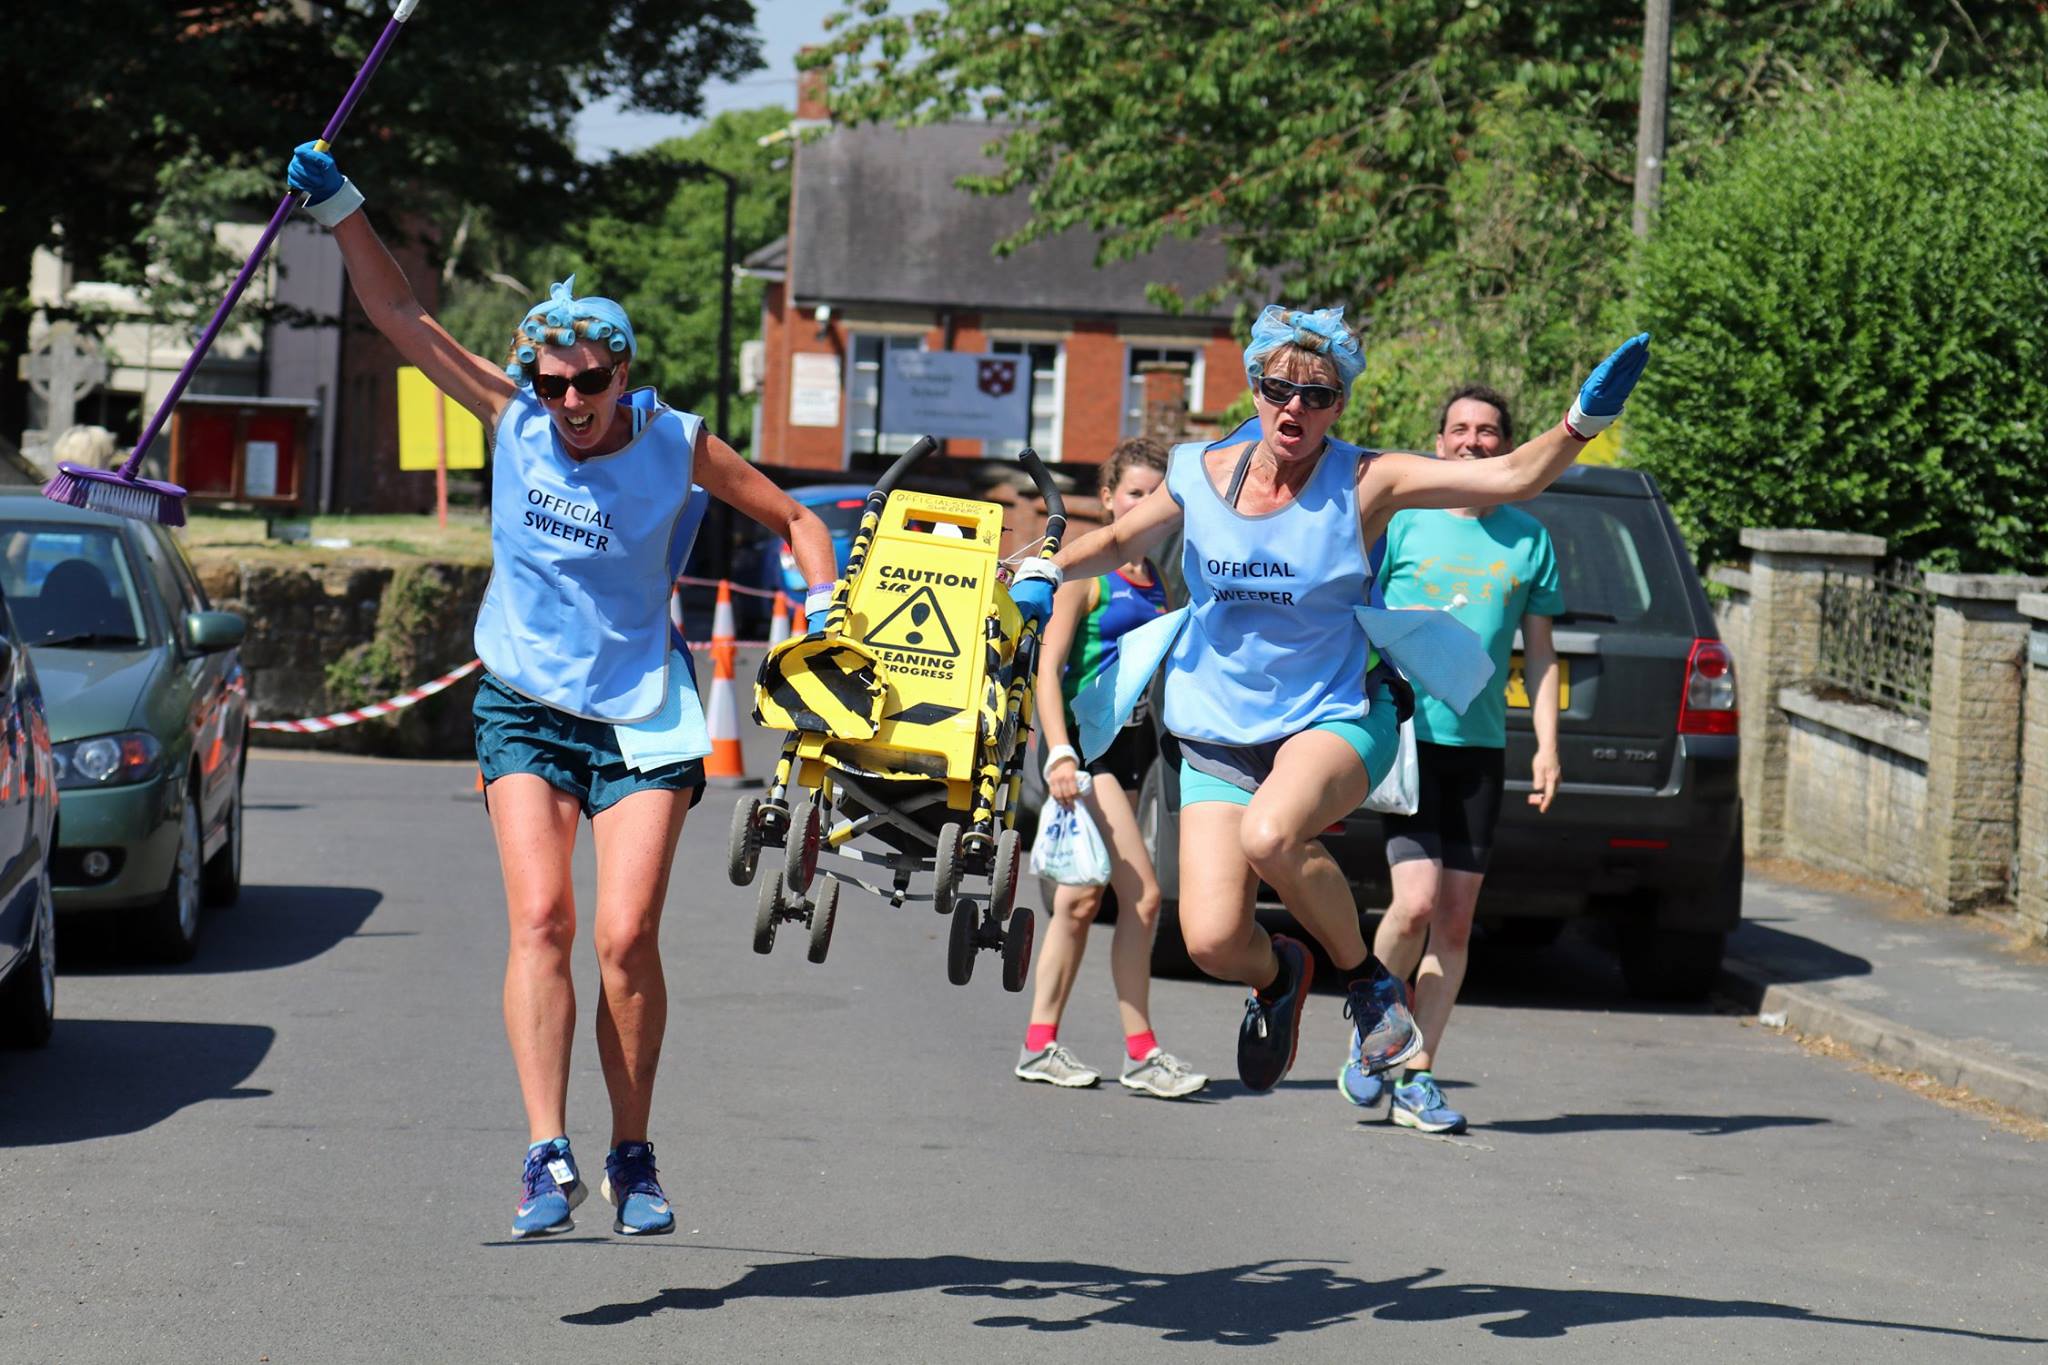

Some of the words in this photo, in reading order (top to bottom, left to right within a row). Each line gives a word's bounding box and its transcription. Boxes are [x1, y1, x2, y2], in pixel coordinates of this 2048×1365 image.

[528, 489, 614, 530] OFFICIAL
[523, 511, 609, 551] SWEEPER
[880, 566, 977, 589] CAUTION
[1207, 560, 1295, 577] OFFICIAL
[876, 581, 911, 593] SIR
[870, 649, 955, 670] LEANING
